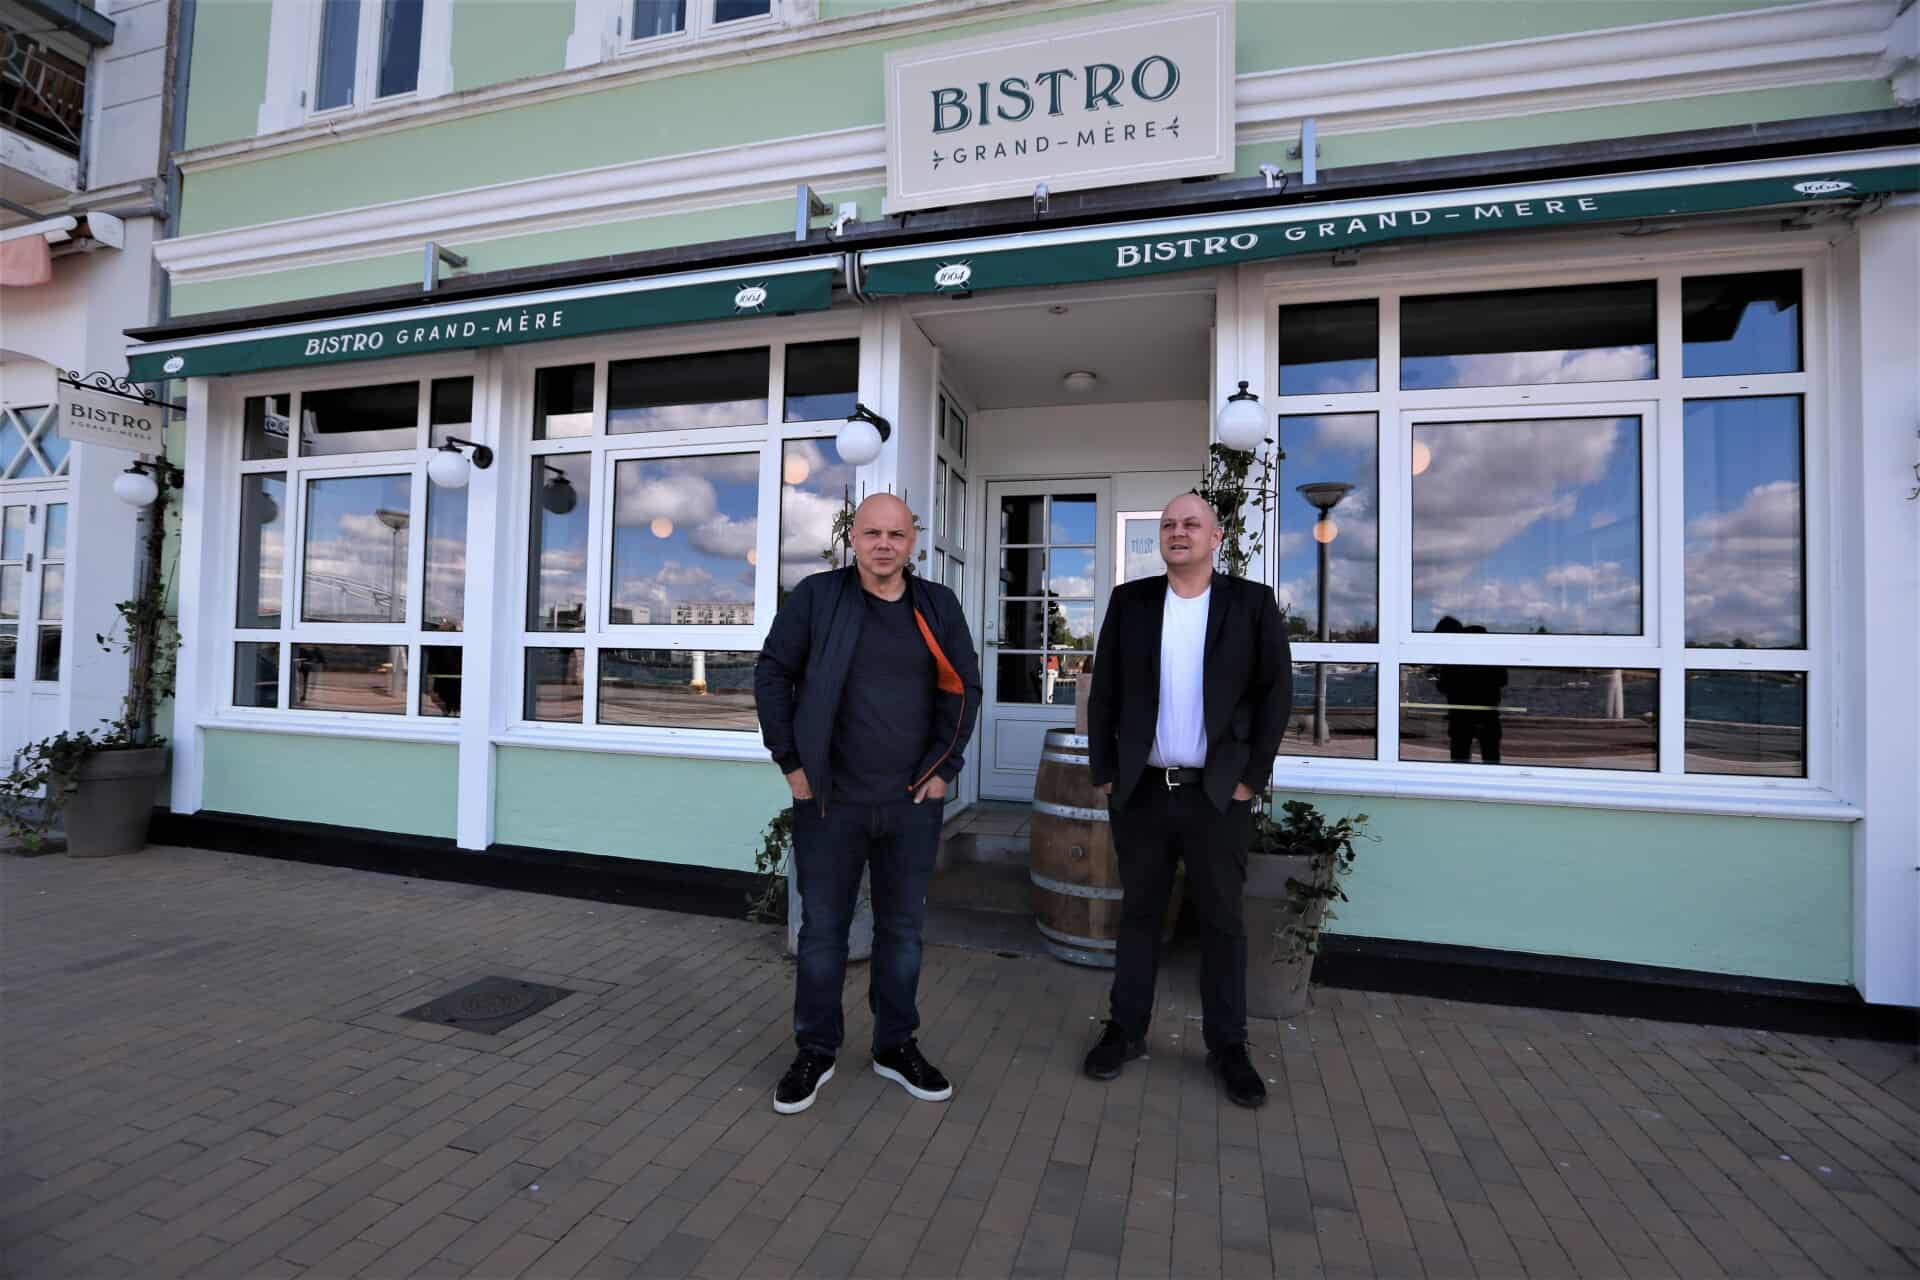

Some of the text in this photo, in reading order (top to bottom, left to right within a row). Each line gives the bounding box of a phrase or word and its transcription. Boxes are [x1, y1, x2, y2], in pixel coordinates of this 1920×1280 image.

[931, 55, 1181, 134] BISTRO
[953, 121, 1156, 164] GRAND-MÈRE
[1116, 197, 1598, 268] BISTRO GRAND-MERE
[304, 309, 563, 356] BISTRO GRAND-MÈRE
[71, 403, 152, 432] BISTRO
